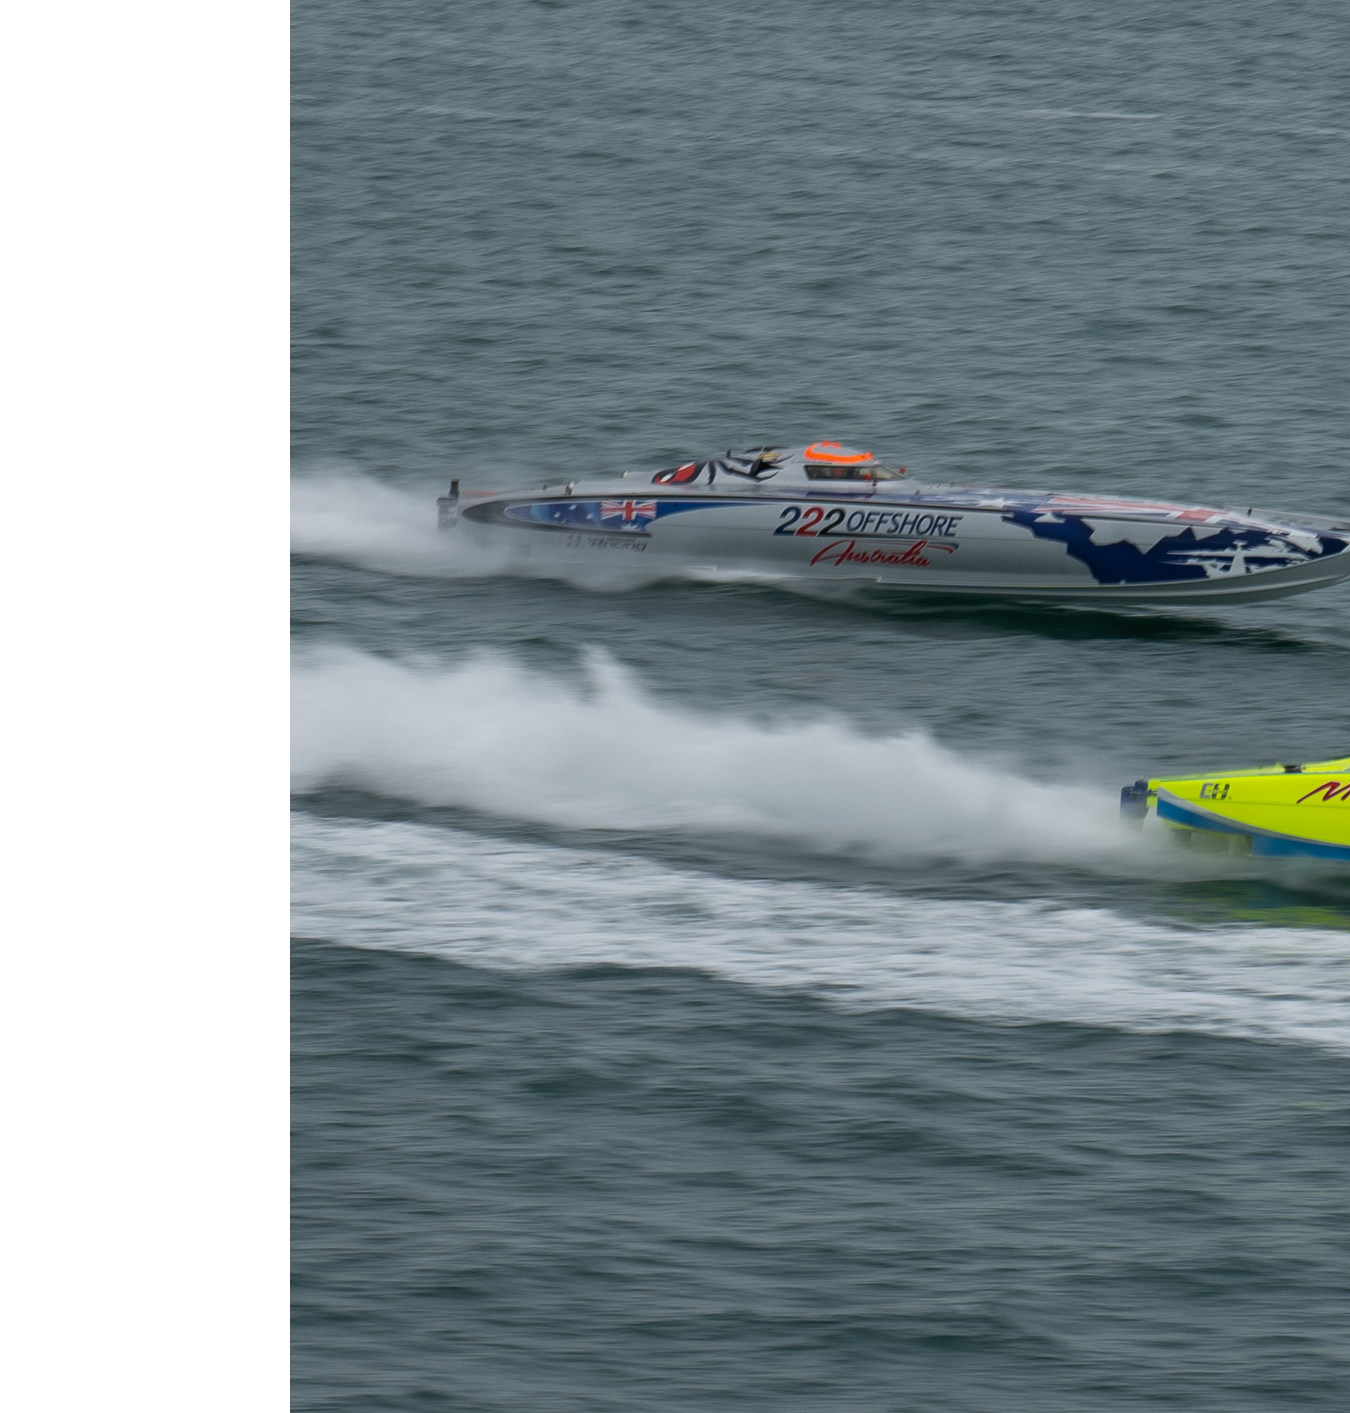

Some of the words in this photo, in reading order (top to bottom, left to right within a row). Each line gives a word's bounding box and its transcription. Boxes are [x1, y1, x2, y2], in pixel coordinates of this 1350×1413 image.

[773, 506, 846, 537] 222
[846, 511, 964, 537] OFFSHORE
[810, 538, 933, 567] Australia
